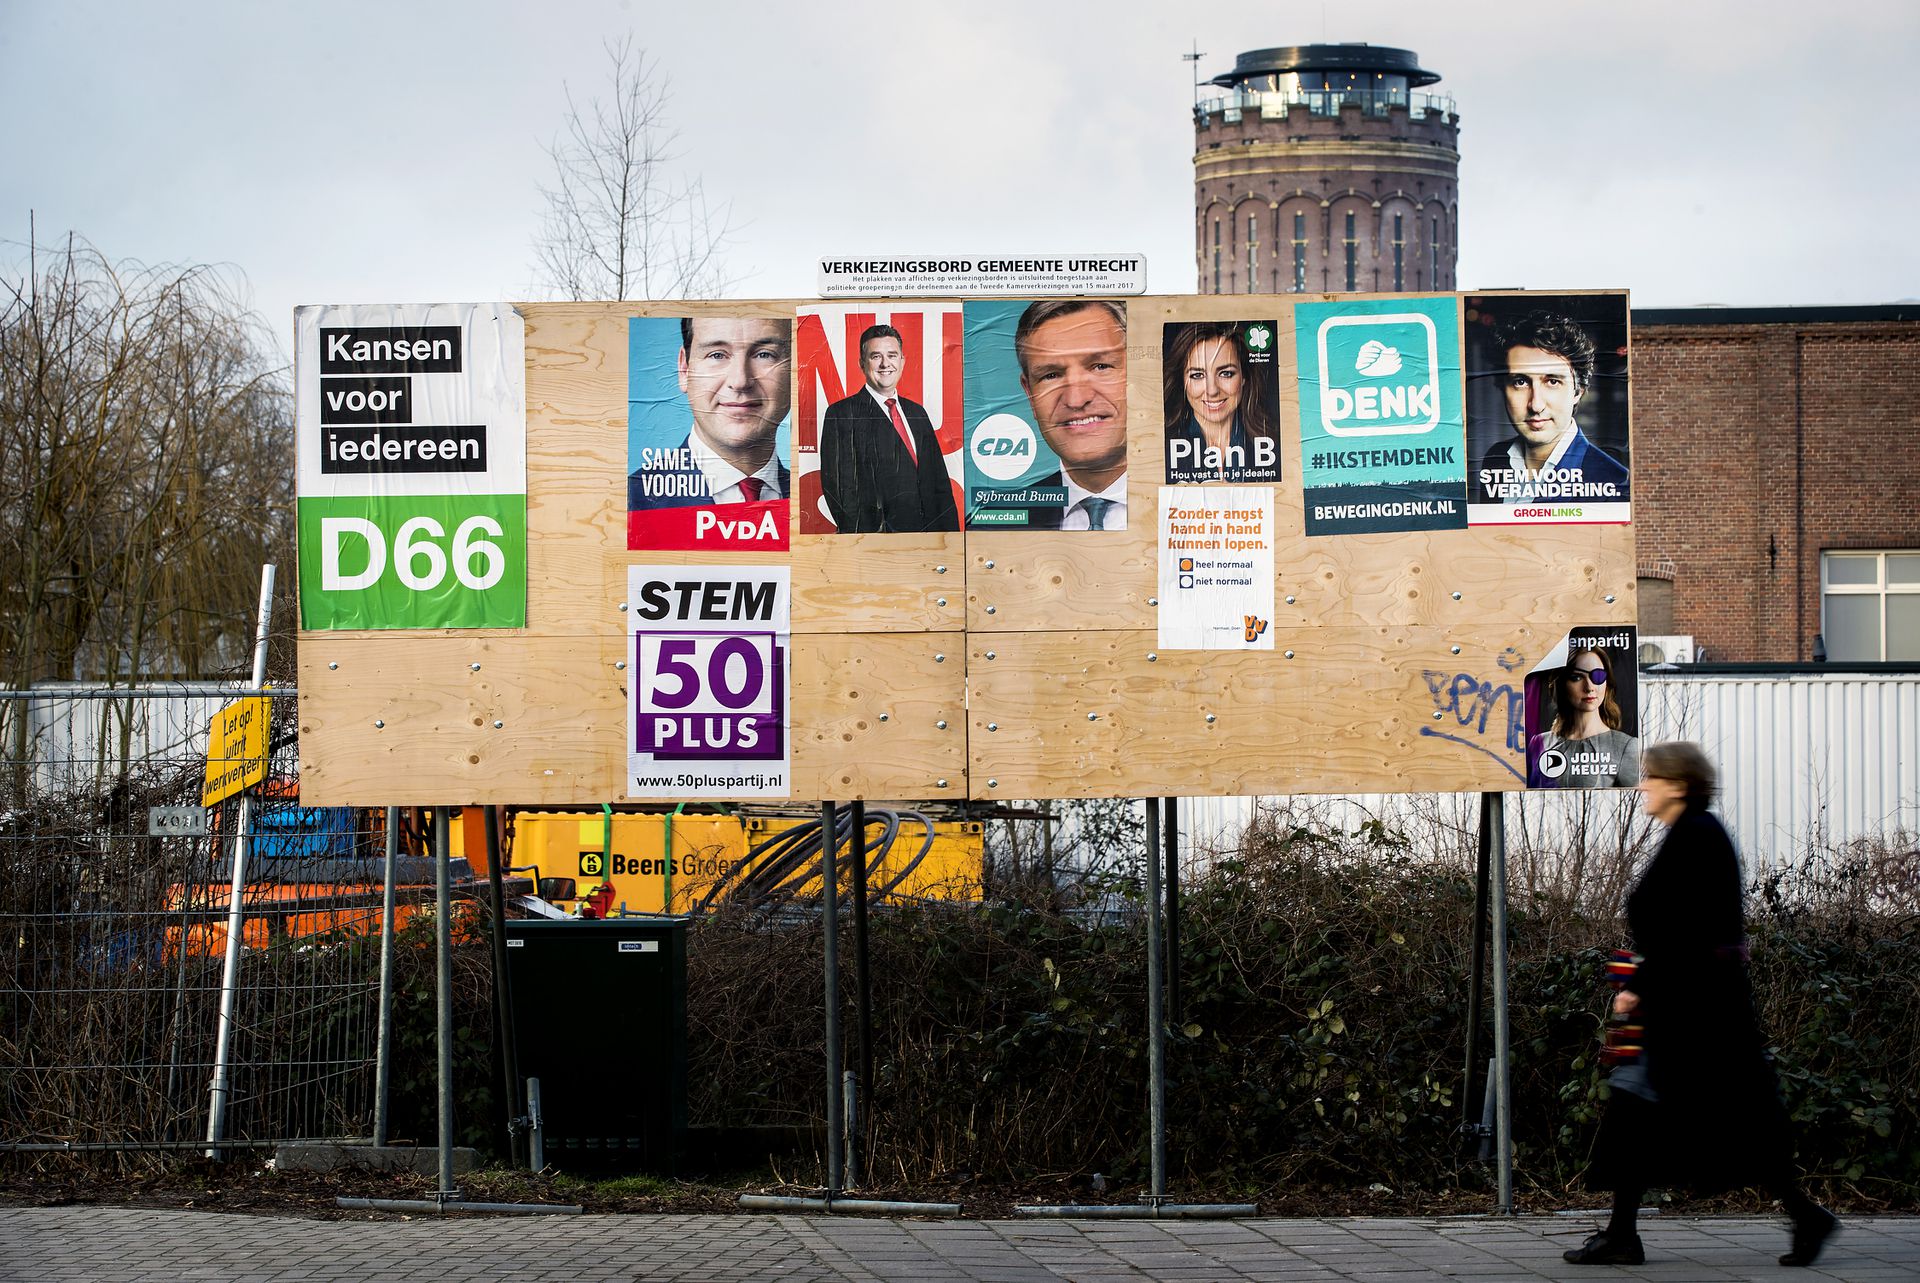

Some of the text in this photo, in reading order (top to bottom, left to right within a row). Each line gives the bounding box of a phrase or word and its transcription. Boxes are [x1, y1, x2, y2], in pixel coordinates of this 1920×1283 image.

[822, 259, 1139, 274] VERKIEZINGSBORD GEMEENTE UTRECHT
[827, 284, 857, 292] politieke
[866, 275, 893, 283] plakken
[947, 274, 1008, 283] verkiezingsborden
[327, 334, 452, 362] Kansen
[326, 387, 403, 412] voor
[1325, 385, 1433, 421] DENK
[329, 433, 480, 461] iedereen
[977, 438, 1029, 456] CDA
[1169, 436, 1276, 469] Plan B
[641, 448, 702, 471] SAMEN
[1311, 446, 1455, 470] #IKSTEMDENK
[1170, 468, 1276, 480] Hou vast aan je idealen
[1479, 468, 1583, 485] STEM VOOR
[641, 474, 717, 498] VOORUIT
[1487, 482, 1621, 499] VERANDERING.
[975, 490, 1065, 504] Sybrand Buma
[974, 512, 1026, 521] www.cda.nl
[1168, 507, 1264, 522] Zonder angst
[1314, 500, 1457, 520] BEWEGINGDENK.NL
[1513, 507, 1584, 518] GROENLINKS
[1170, 522, 1262, 535] hand in hand
[321, 515, 506, 592] D66
[1168, 537, 1268, 552] kunnen lopen.
[1195, 560, 1253, 569] heel normaal
[1195, 577, 1252, 586] niet normaal
[636, 580, 778, 621] STEM
[1244, 615, 1269, 643] VVD
[651, 637, 764, 710] 50
[224, 703, 254, 736] Let op!
[654, 717, 759, 748] PLUS
[226, 735, 247, 759] uitrit
[1571, 752, 1611, 764] JOUW
[206, 754, 262, 794] werkverkeer
[1571, 764, 1618, 776] KEUZE
[636, 774, 783, 790] www.50pluspartij.nl
[612, 854, 679, 875] Beens
